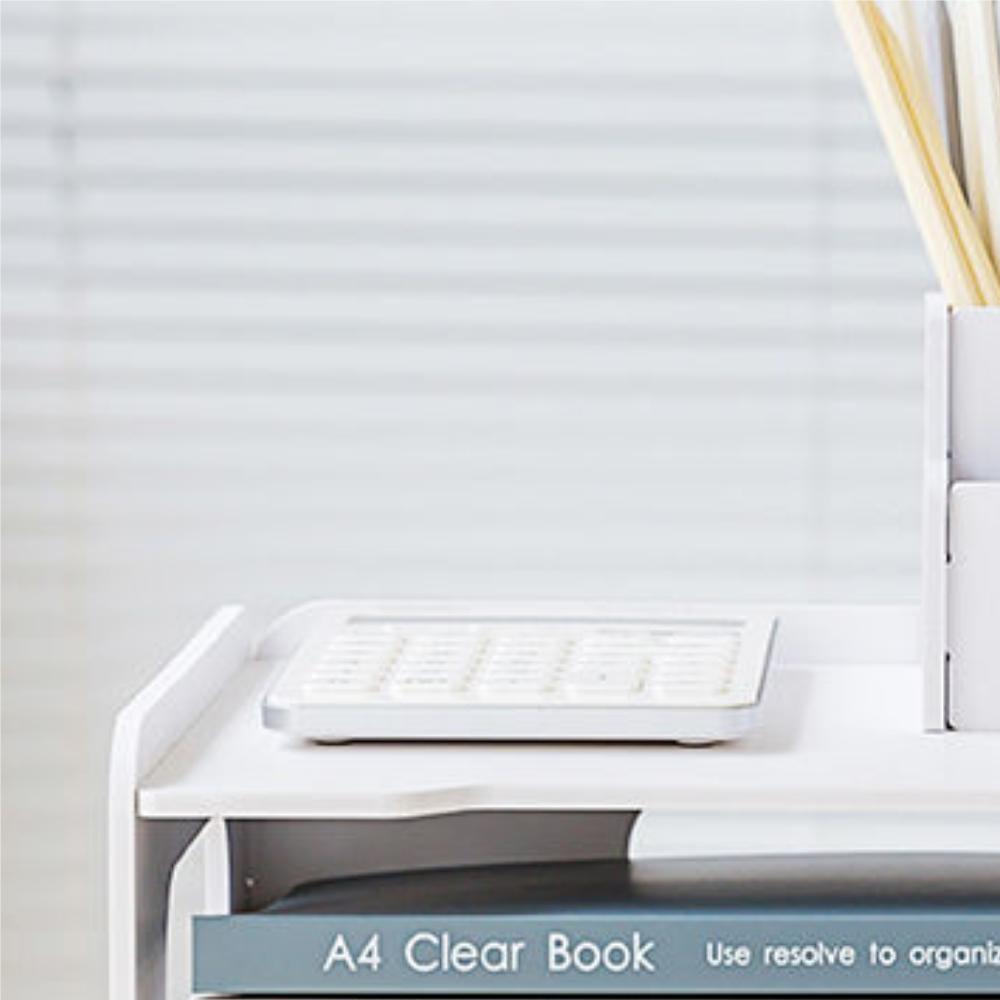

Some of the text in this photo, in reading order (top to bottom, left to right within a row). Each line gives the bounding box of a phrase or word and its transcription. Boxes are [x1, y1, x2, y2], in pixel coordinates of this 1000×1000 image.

[323, 931, 655, 972] A4 Clear Book
[706, 941, 751, 967] Use
[763, 941, 856, 966] resolve
[869, 941, 897, 966] to
